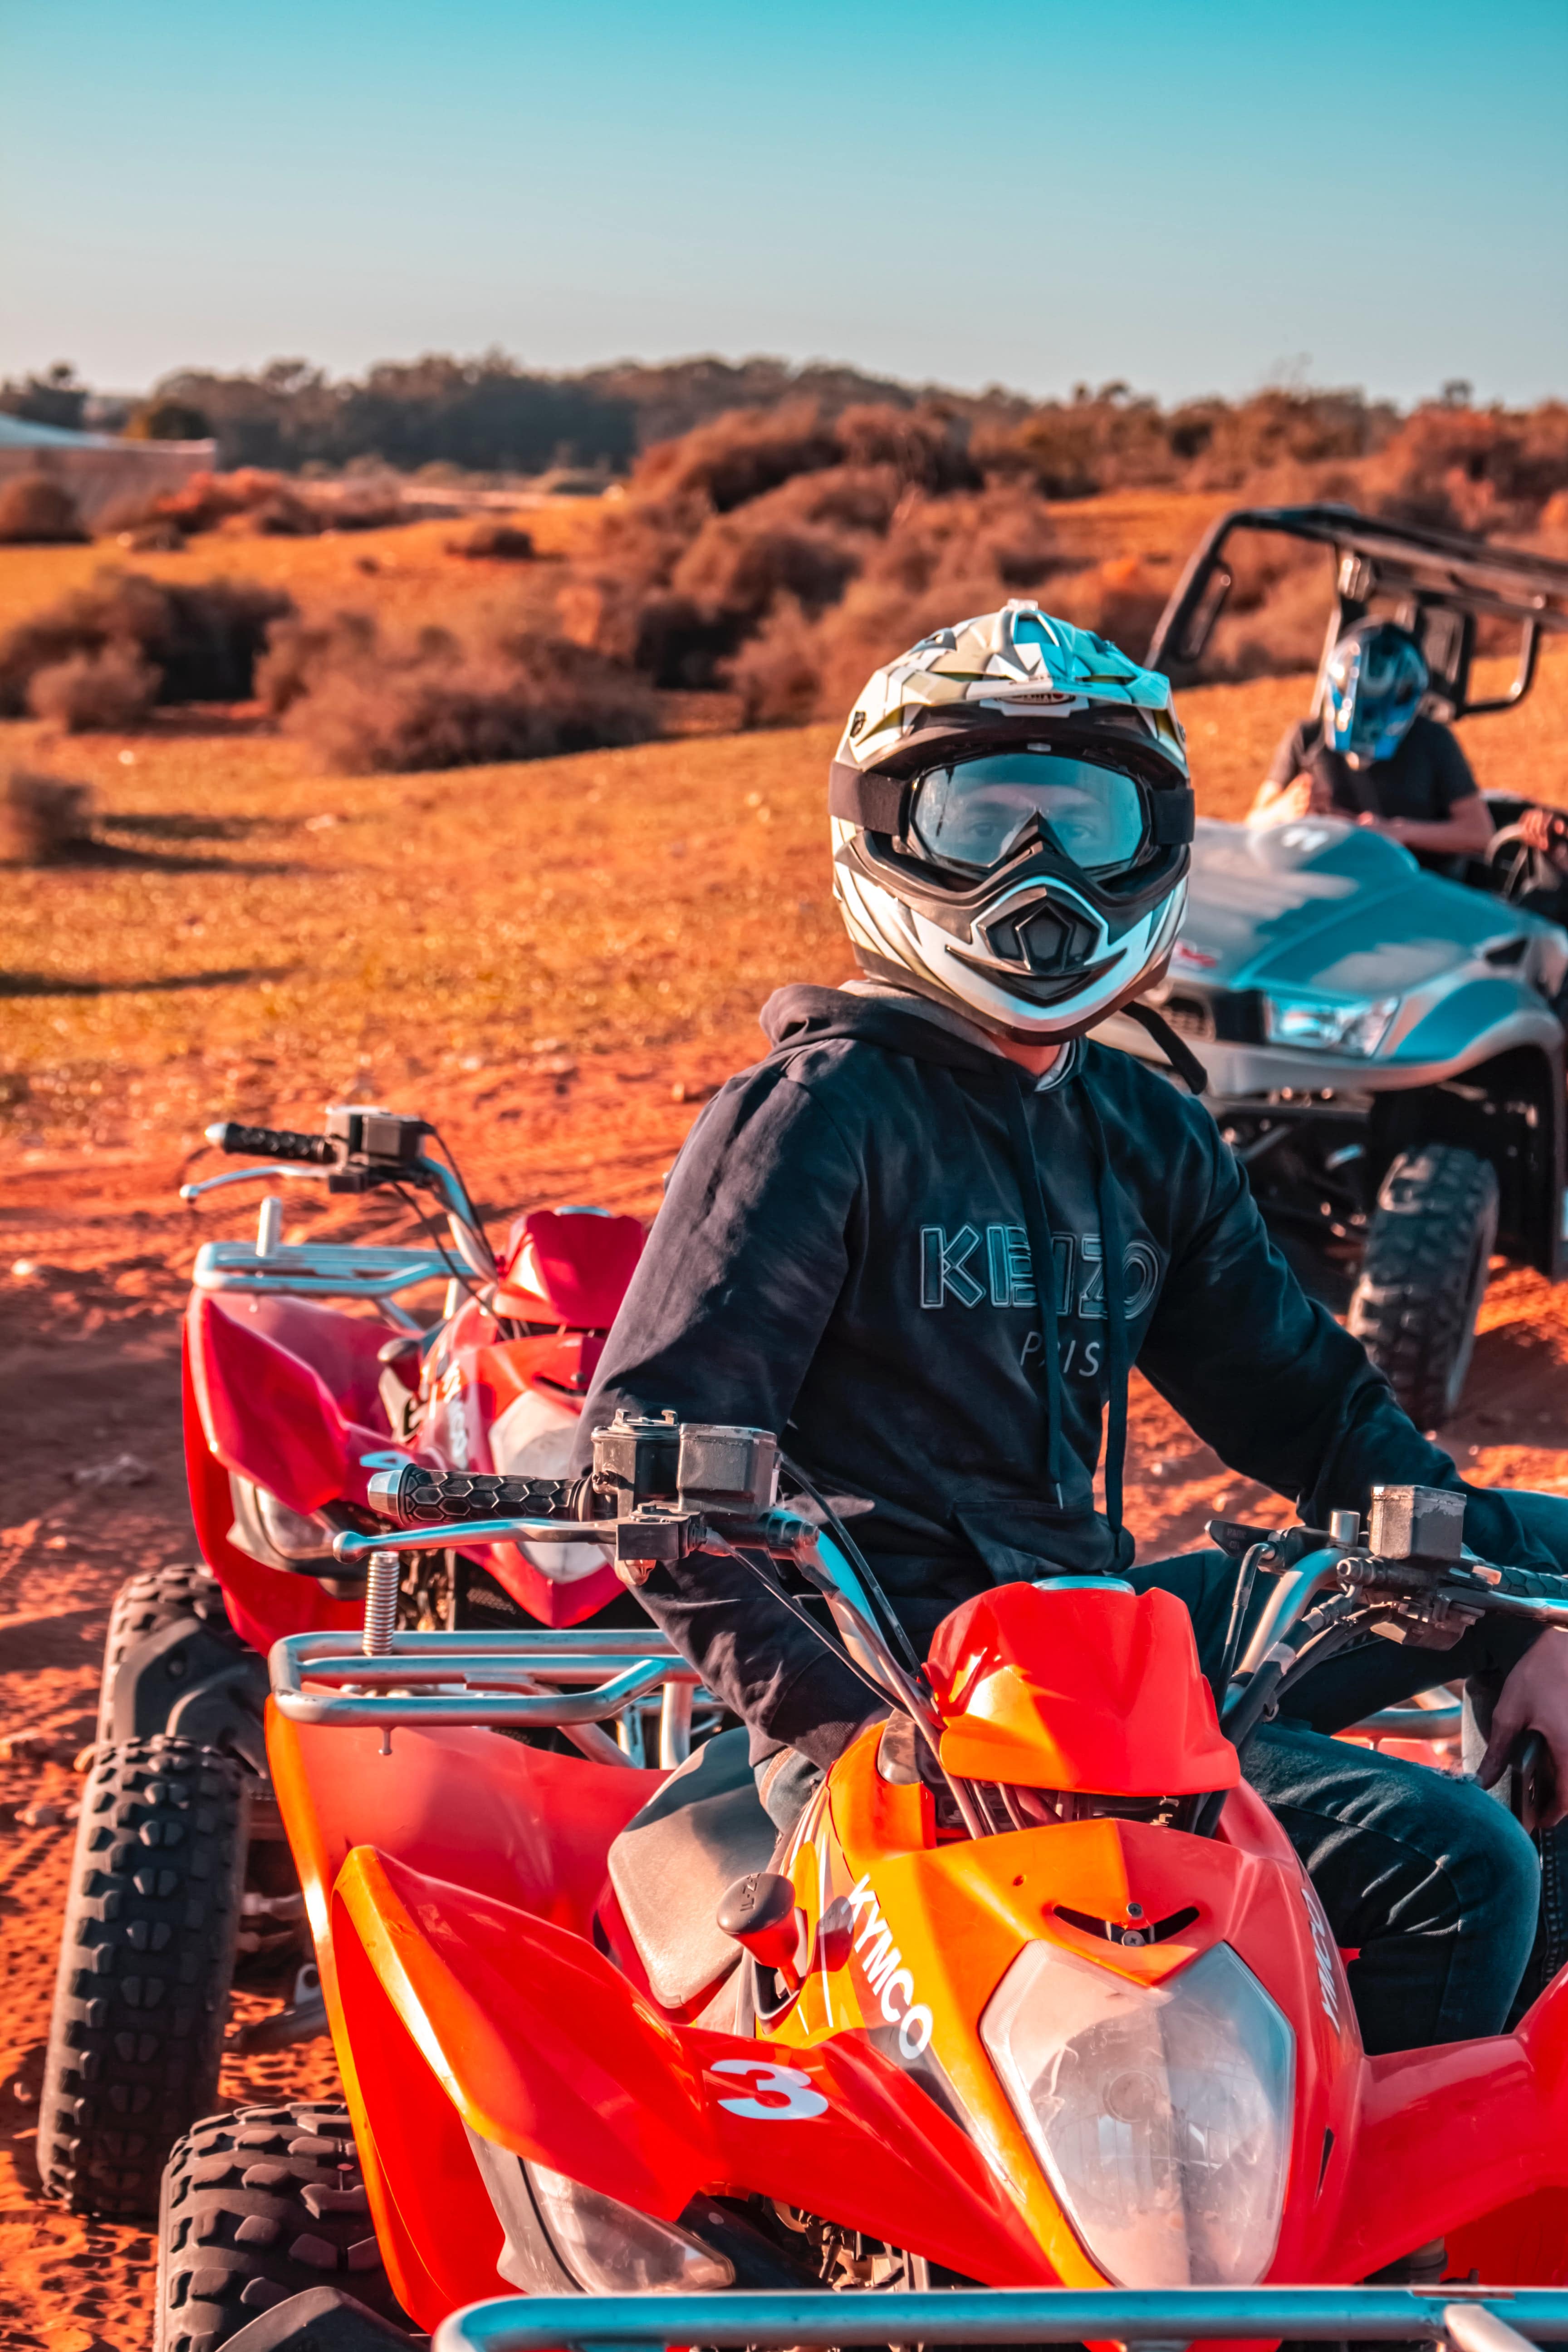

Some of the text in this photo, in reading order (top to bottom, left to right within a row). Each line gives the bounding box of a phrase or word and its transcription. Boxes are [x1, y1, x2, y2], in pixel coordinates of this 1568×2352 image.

[920, 1223, 1159, 1320] KEZO
[1019, 1331, 1100, 1377] PIS
[841, 1873, 933, 2060] KYMCO
[710, 2059, 829, 2120] 3
